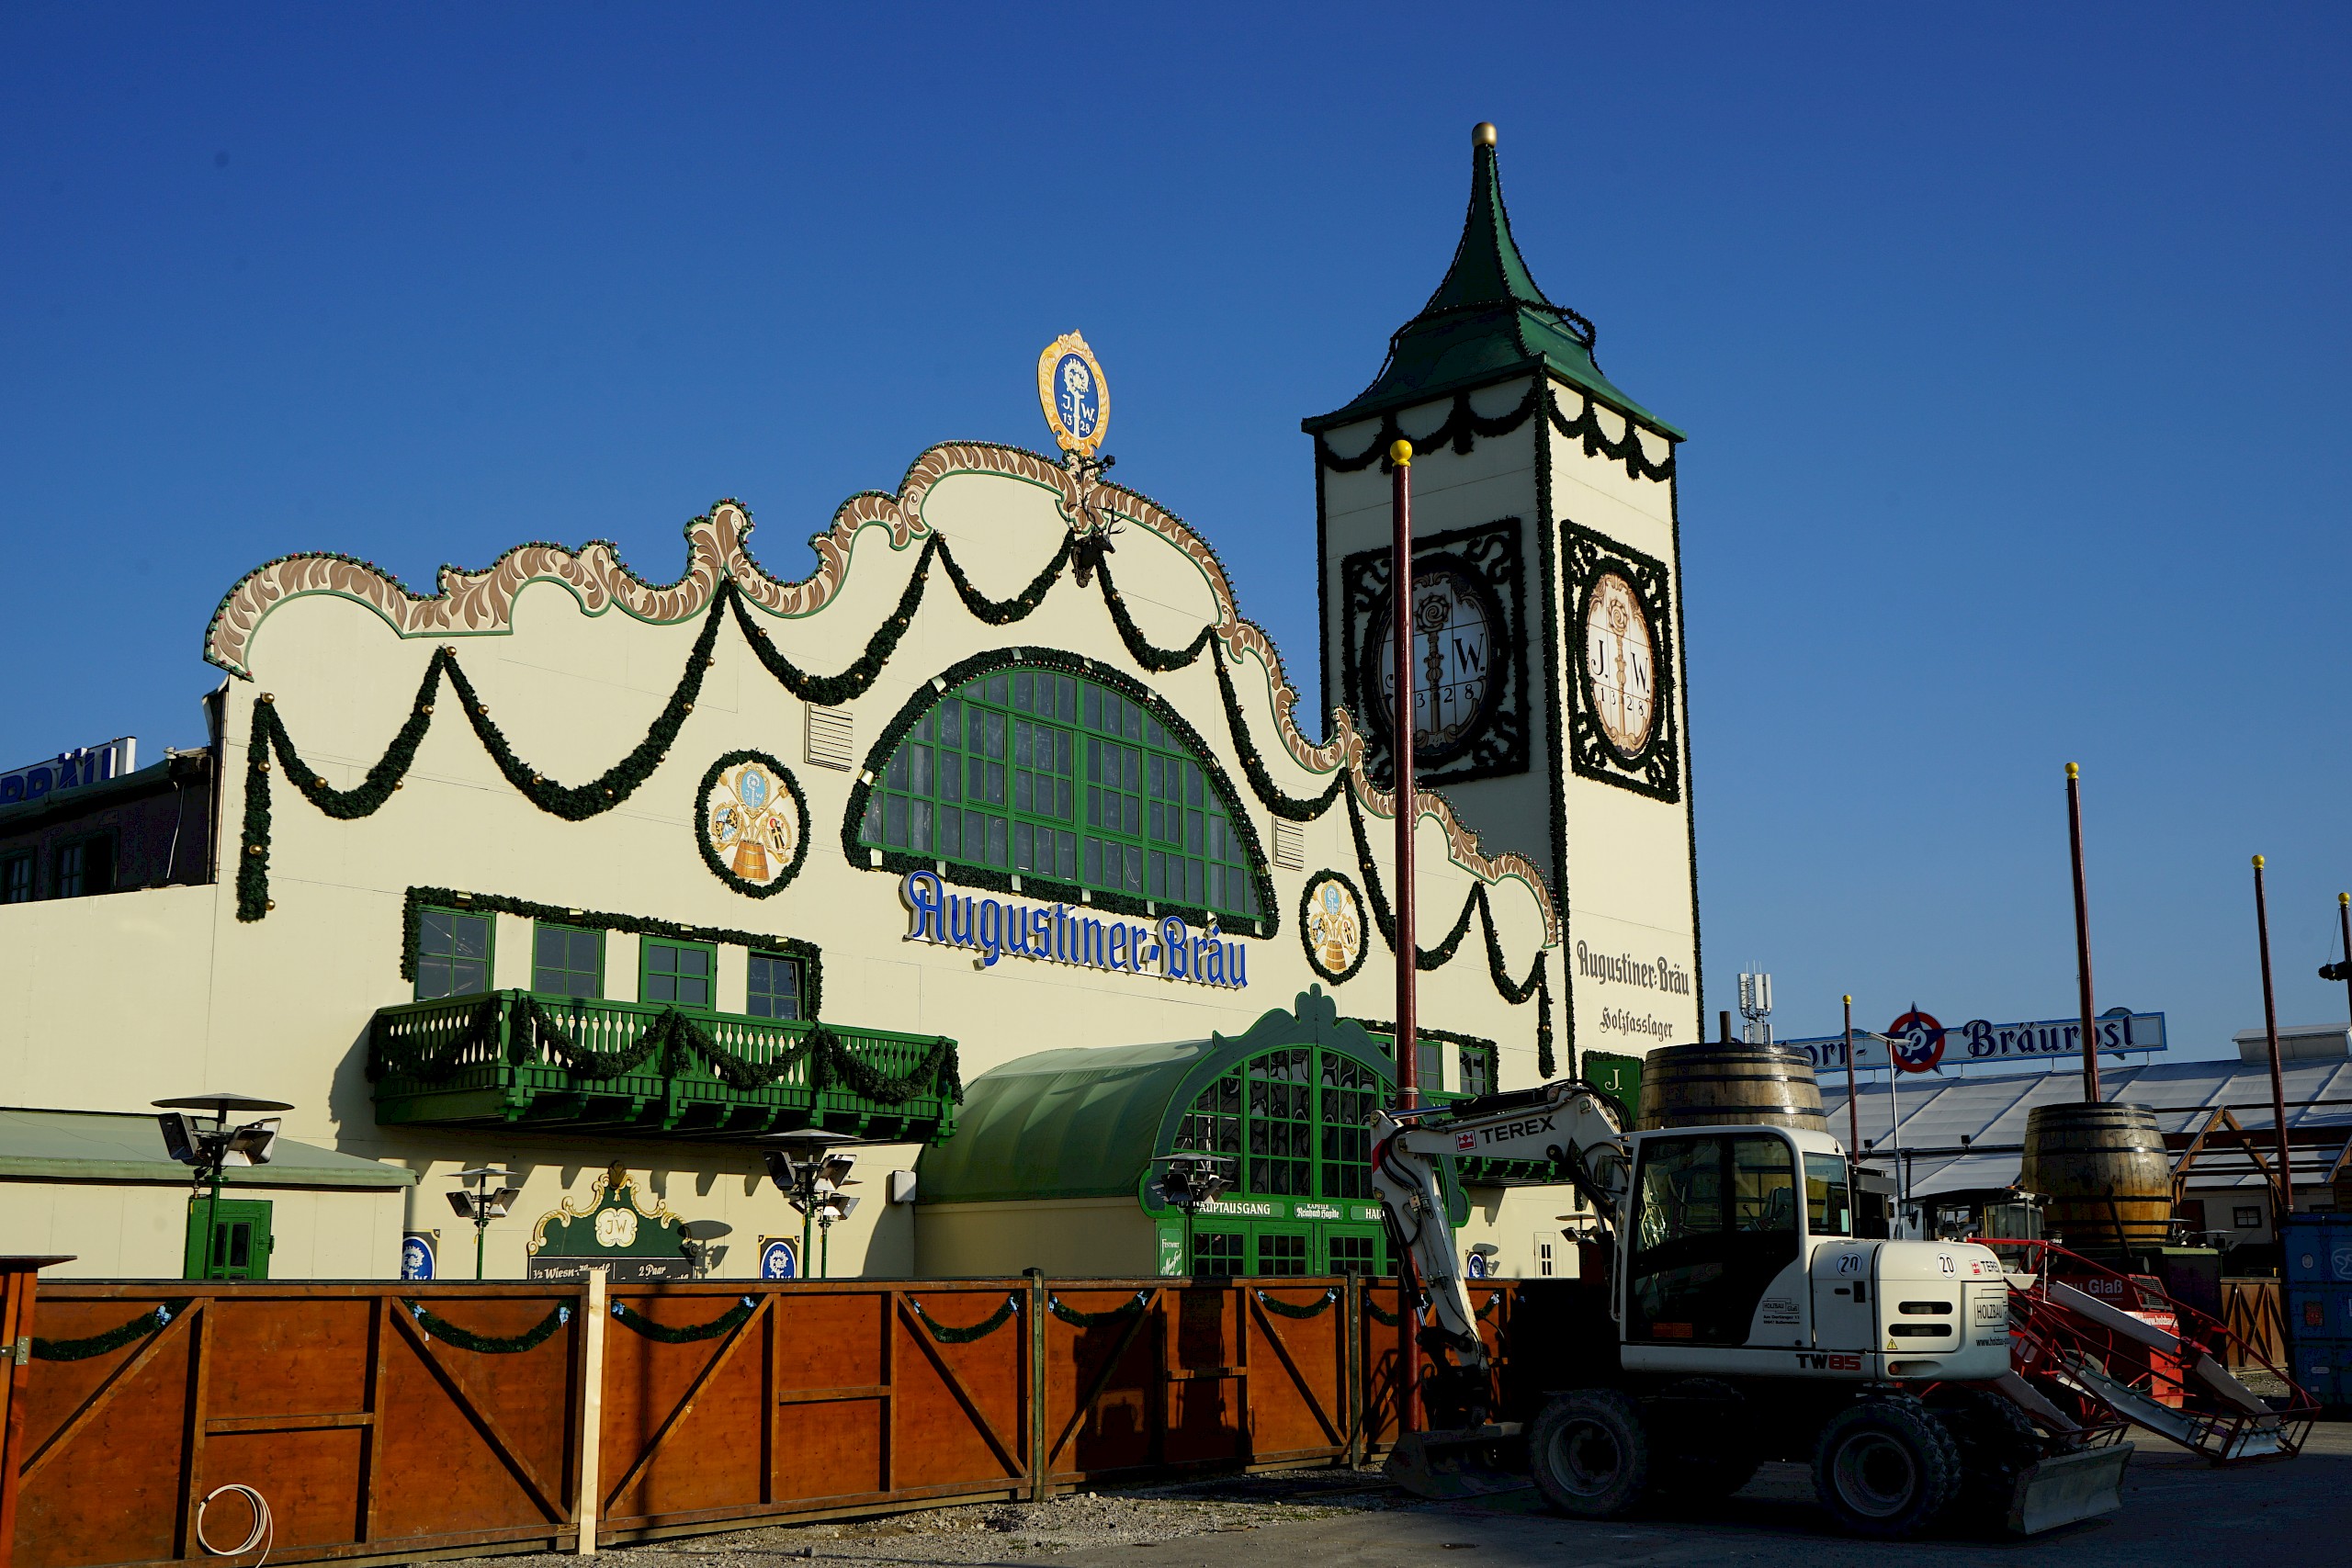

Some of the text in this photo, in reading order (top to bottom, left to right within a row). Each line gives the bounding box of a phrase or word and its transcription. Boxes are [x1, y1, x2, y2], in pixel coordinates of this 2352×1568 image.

[1599, 1006, 1673, 1043] Holzfasslager
[1479, 1115, 1556, 1145] TEREX
[638, 1263, 666, 1278] 2 Paar
[1939, 1256, 1954, 1273] 20
[2087, 1279, 2123, 1295] Glaß
[1976, 1304, 2003, 1320] HOLZBAU
[1795, 1353, 1861, 1371] TW85
